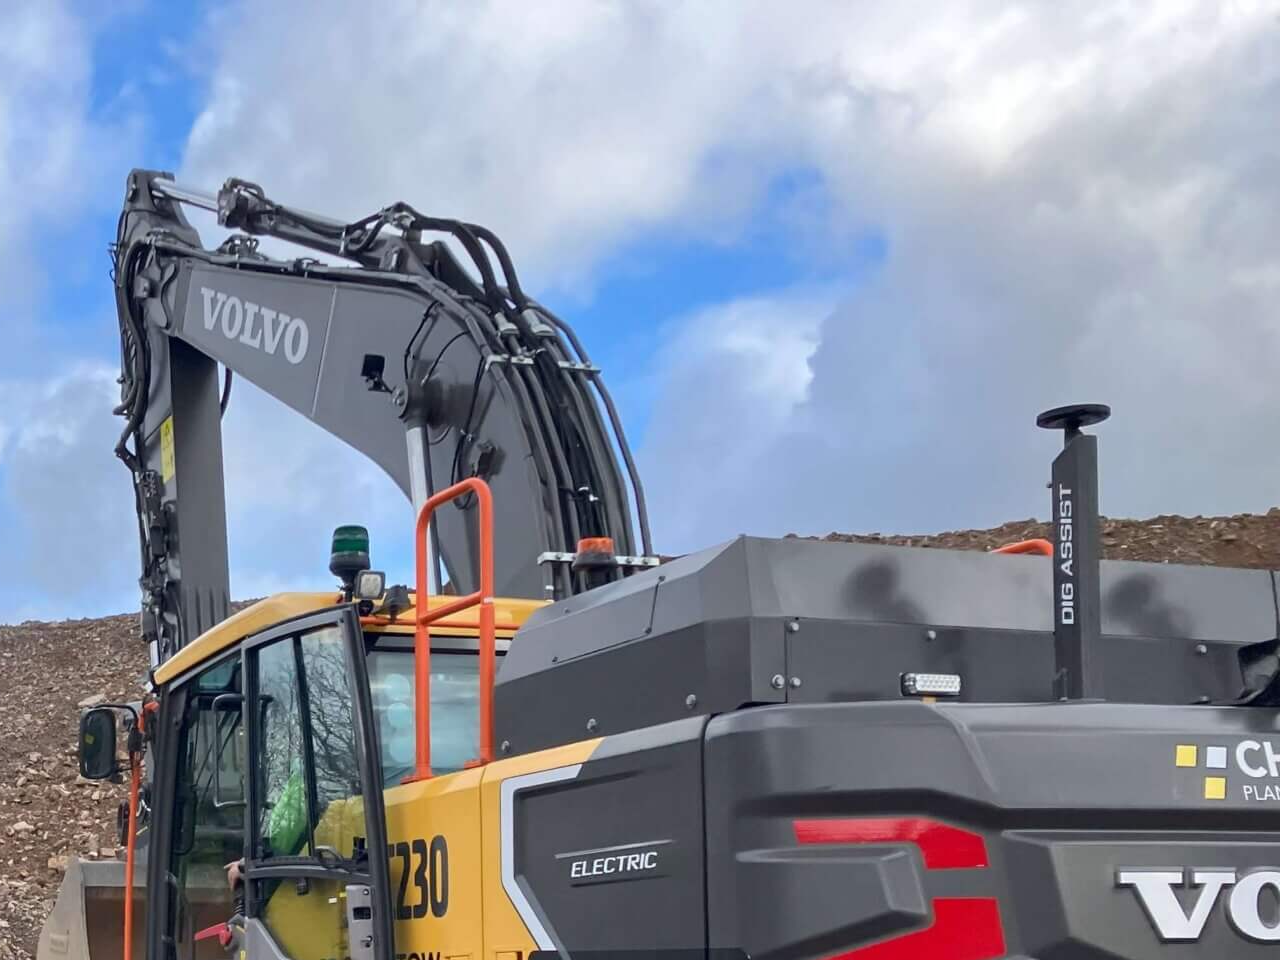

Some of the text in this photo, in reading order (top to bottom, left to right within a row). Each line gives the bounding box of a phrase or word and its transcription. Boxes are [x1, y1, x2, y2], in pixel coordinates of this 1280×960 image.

[200, 287, 309, 364] VOLVO
[1059, 483, 1075, 625] DIG ASSIST
[388, 835, 449, 921] 230
[570, 851, 658, 878] ELECTRIC
